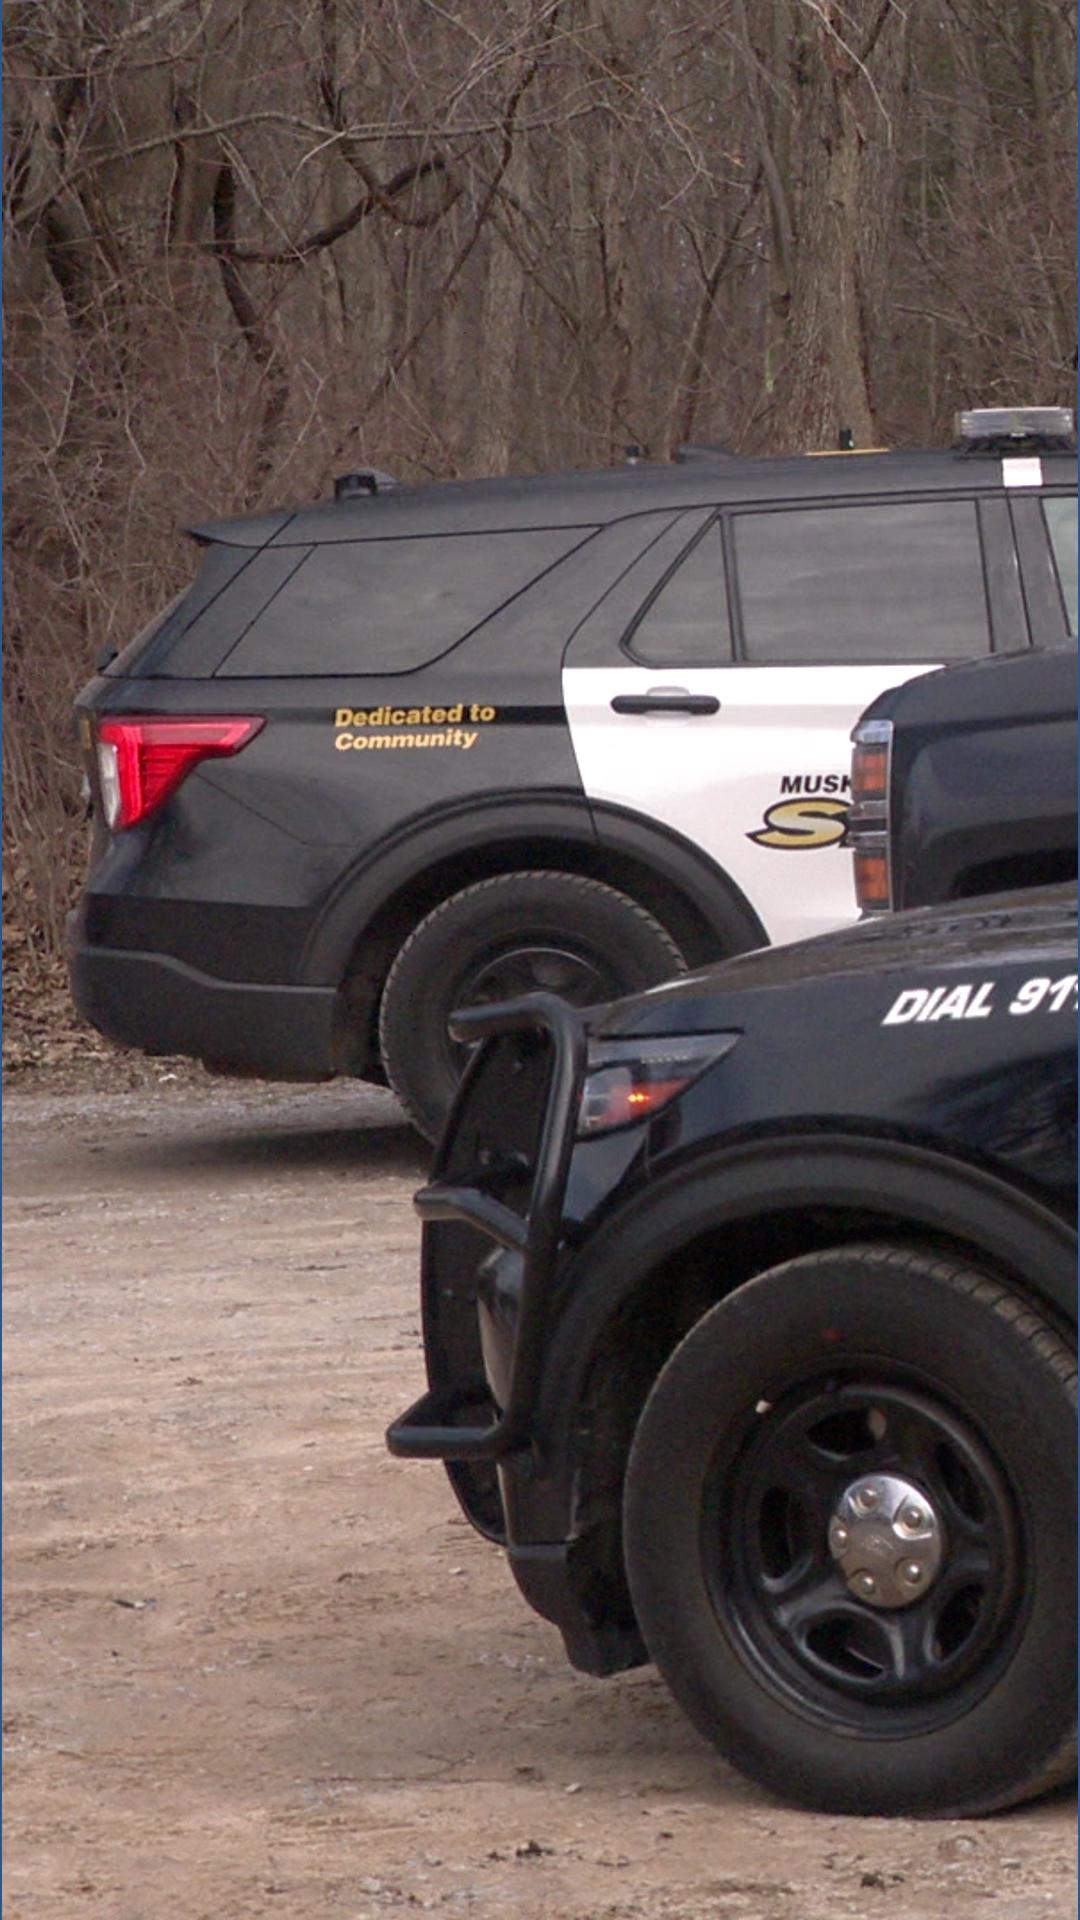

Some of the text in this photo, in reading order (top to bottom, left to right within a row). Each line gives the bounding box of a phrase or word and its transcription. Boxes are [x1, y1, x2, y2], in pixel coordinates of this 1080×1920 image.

[335, 703, 495, 727] Dedicated to
[335, 729, 478, 750] Community
[881, 974, 1078, 1025] DIAL 91
